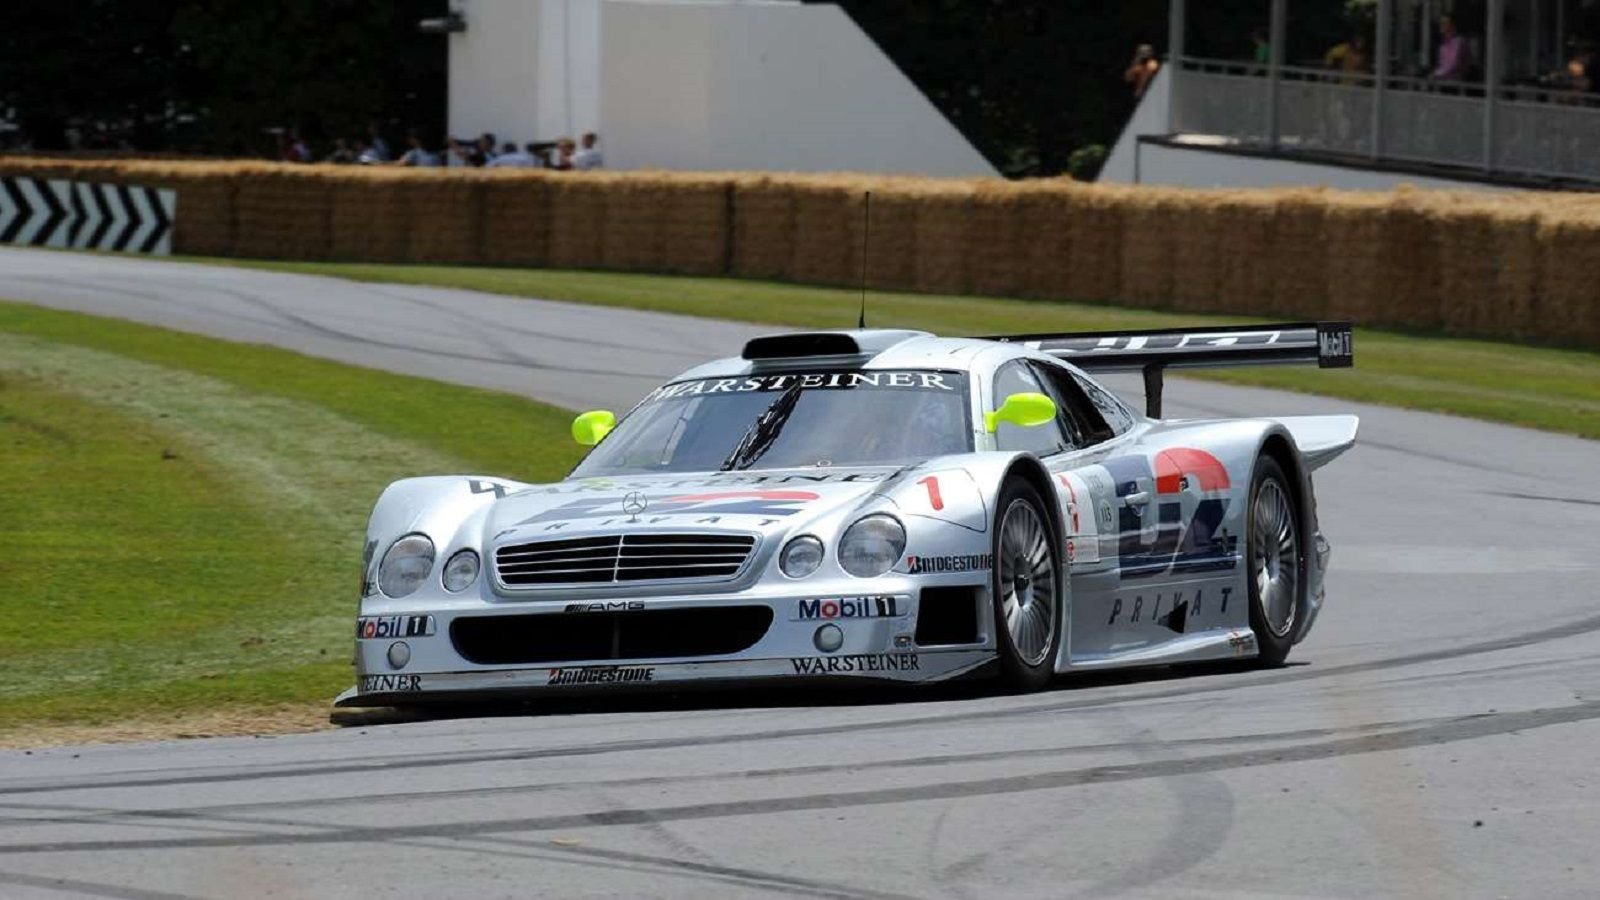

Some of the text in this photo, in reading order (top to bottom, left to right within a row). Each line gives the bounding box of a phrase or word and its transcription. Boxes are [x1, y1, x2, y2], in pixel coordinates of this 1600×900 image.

[653, 372, 954, 401] WARSTEINER
[917, 476, 944, 511] 1
[799, 597, 896, 619] Mobil 1
[1108, 587, 1232, 625] PRIVAT
[791, 653, 919, 674] WARSTEINER
[548, 668, 655, 685] BRIDGESTONE
